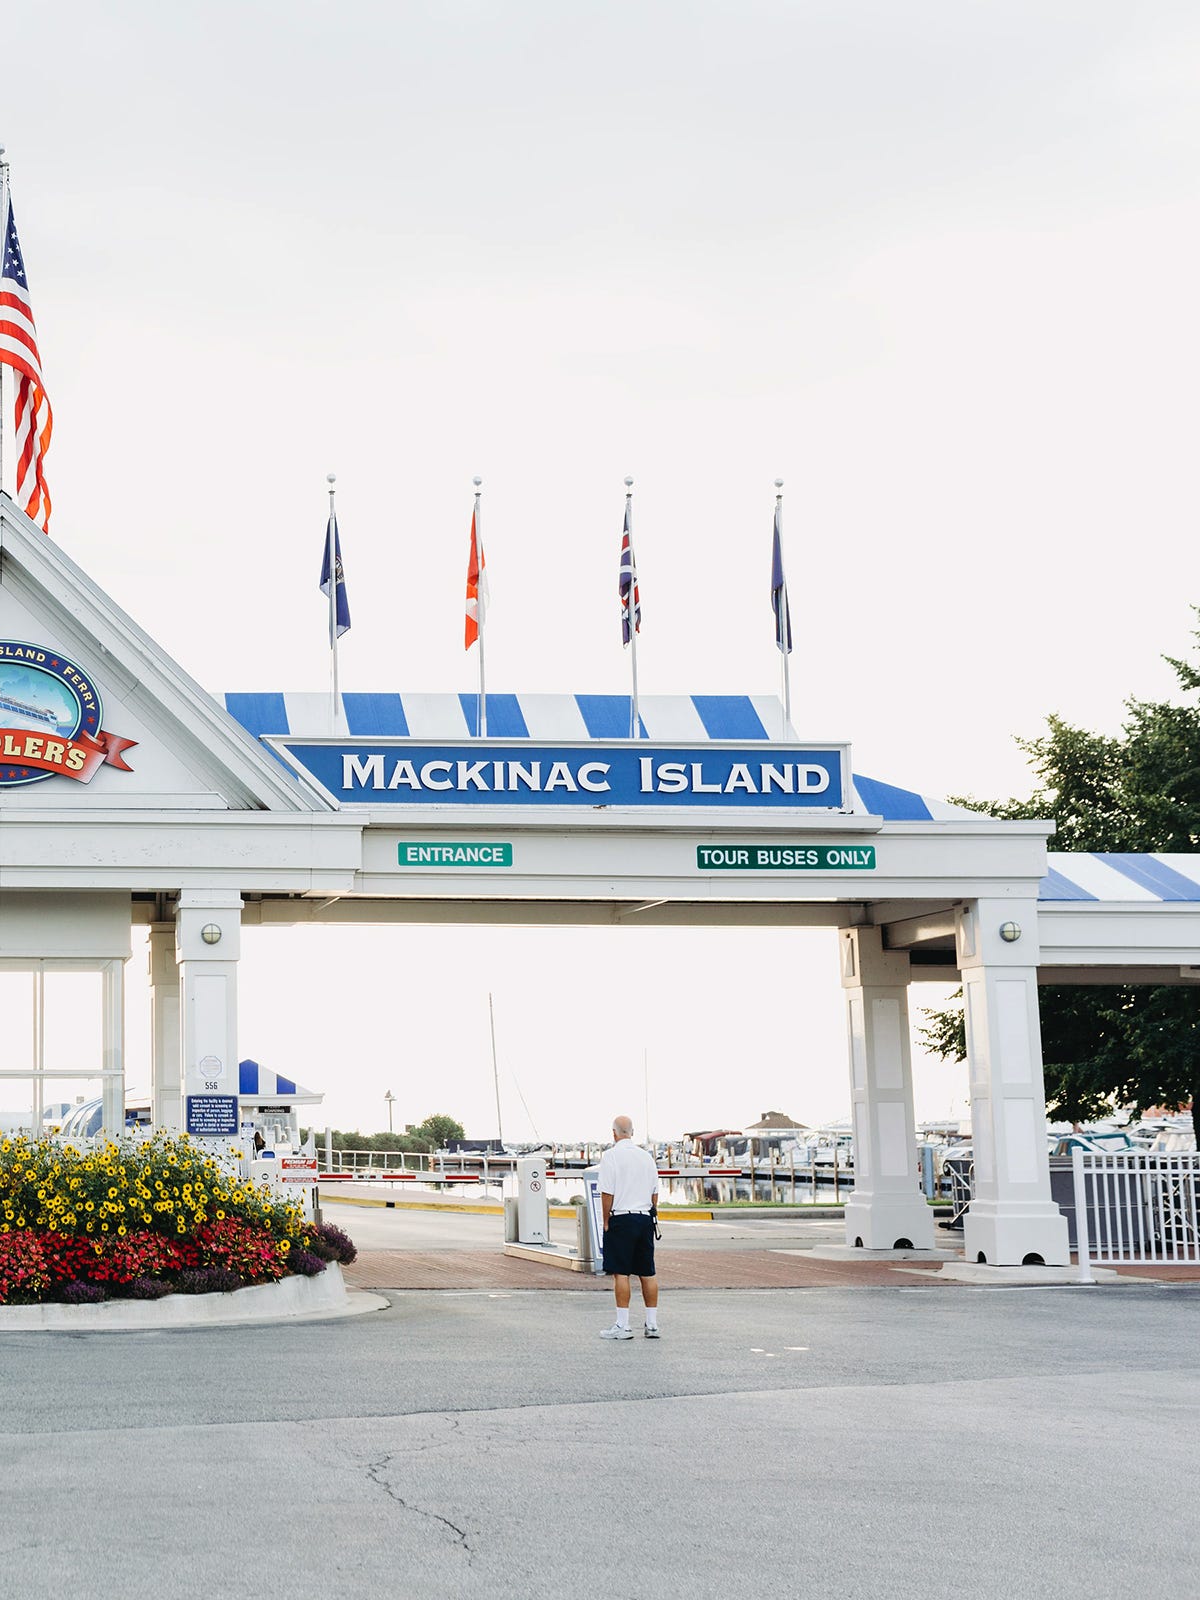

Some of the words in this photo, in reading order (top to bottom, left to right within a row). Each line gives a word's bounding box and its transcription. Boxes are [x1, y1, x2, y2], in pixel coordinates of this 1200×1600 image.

[63, 665, 96, 711] FERRY
[341, 754, 612, 792] MACKINAC
[639, 757, 830, 794] ISLAND
[406, 846, 504, 862] ENTRANCE
[700, 849, 749, 865] TOUR
[757, 849, 819, 865] BUSES
[826, 849, 872, 865] ONLY
